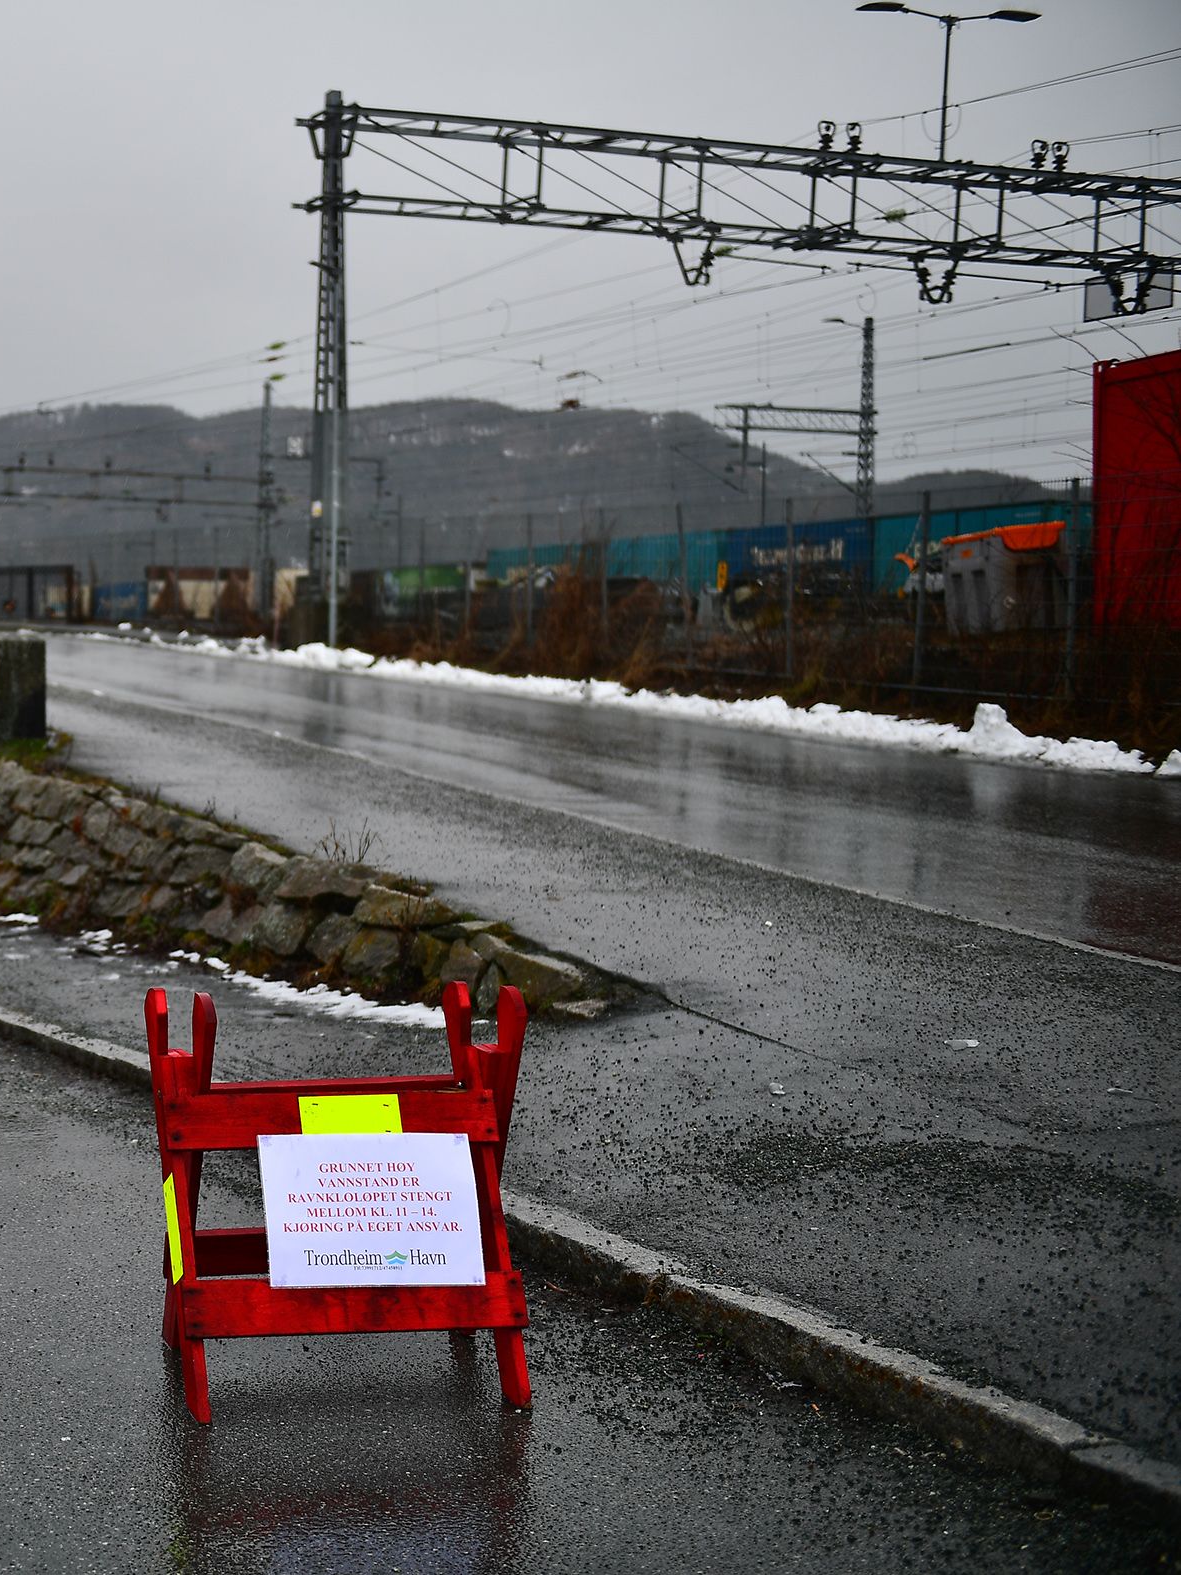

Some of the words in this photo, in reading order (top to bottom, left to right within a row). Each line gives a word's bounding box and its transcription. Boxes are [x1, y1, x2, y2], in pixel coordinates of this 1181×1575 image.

[319, 1162, 382, 1173] GRUNNET
[387, 1162, 415, 1172] HØY
[317, 1177, 399, 1188] VANNSTAND
[402, 1176, 420, 1187] ER
[287, 1191, 396, 1204] RAVNKLOLØPET
[400, 1191, 452, 1202] STENGT
[307, 1207, 366, 1218] MELLOM
[371, 1207, 393, 1217] KL.
[396, 1206, 407, 1217] 11
[421, 1206, 437, 1217] 14.
[283, 1222, 343, 1233] KJØRING
[347, 1220, 364, 1233] PÅ
[369, 1221, 403, 1232] EGET
[406, 1221, 463, 1232] ANSVAR.
[304, 1249, 383, 1266] Trondheim
[409, 1249, 447, 1265] Havn
